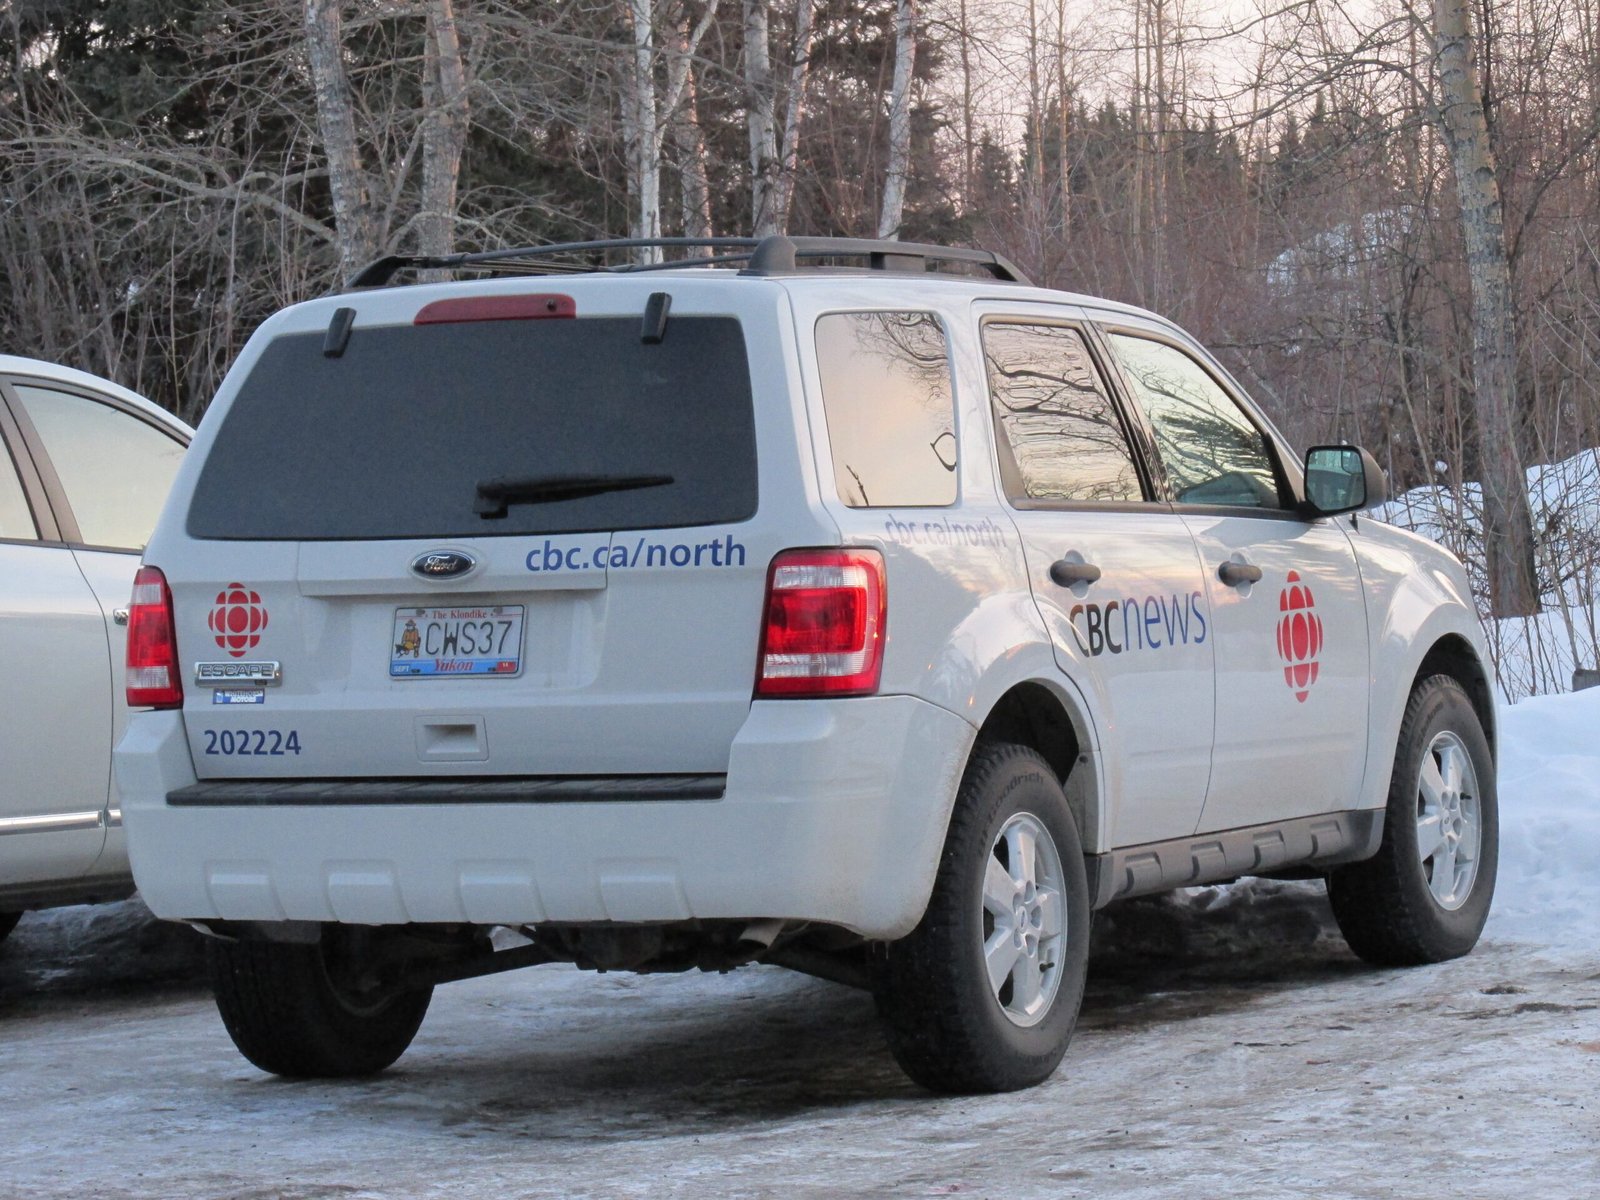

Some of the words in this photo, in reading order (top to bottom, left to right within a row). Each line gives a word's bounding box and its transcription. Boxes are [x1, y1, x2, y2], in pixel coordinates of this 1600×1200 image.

[525, 534, 746, 571] cbc.ca/north
[433, 610, 447, 619] The
[450, 609, 487, 619] Klondike
[425, 621, 512, 655] CWS37
[201, 665, 273, 677] ESCAPE
[435, 659, 474, 672] Yukon
[204, 730, 302, 755] 202224
